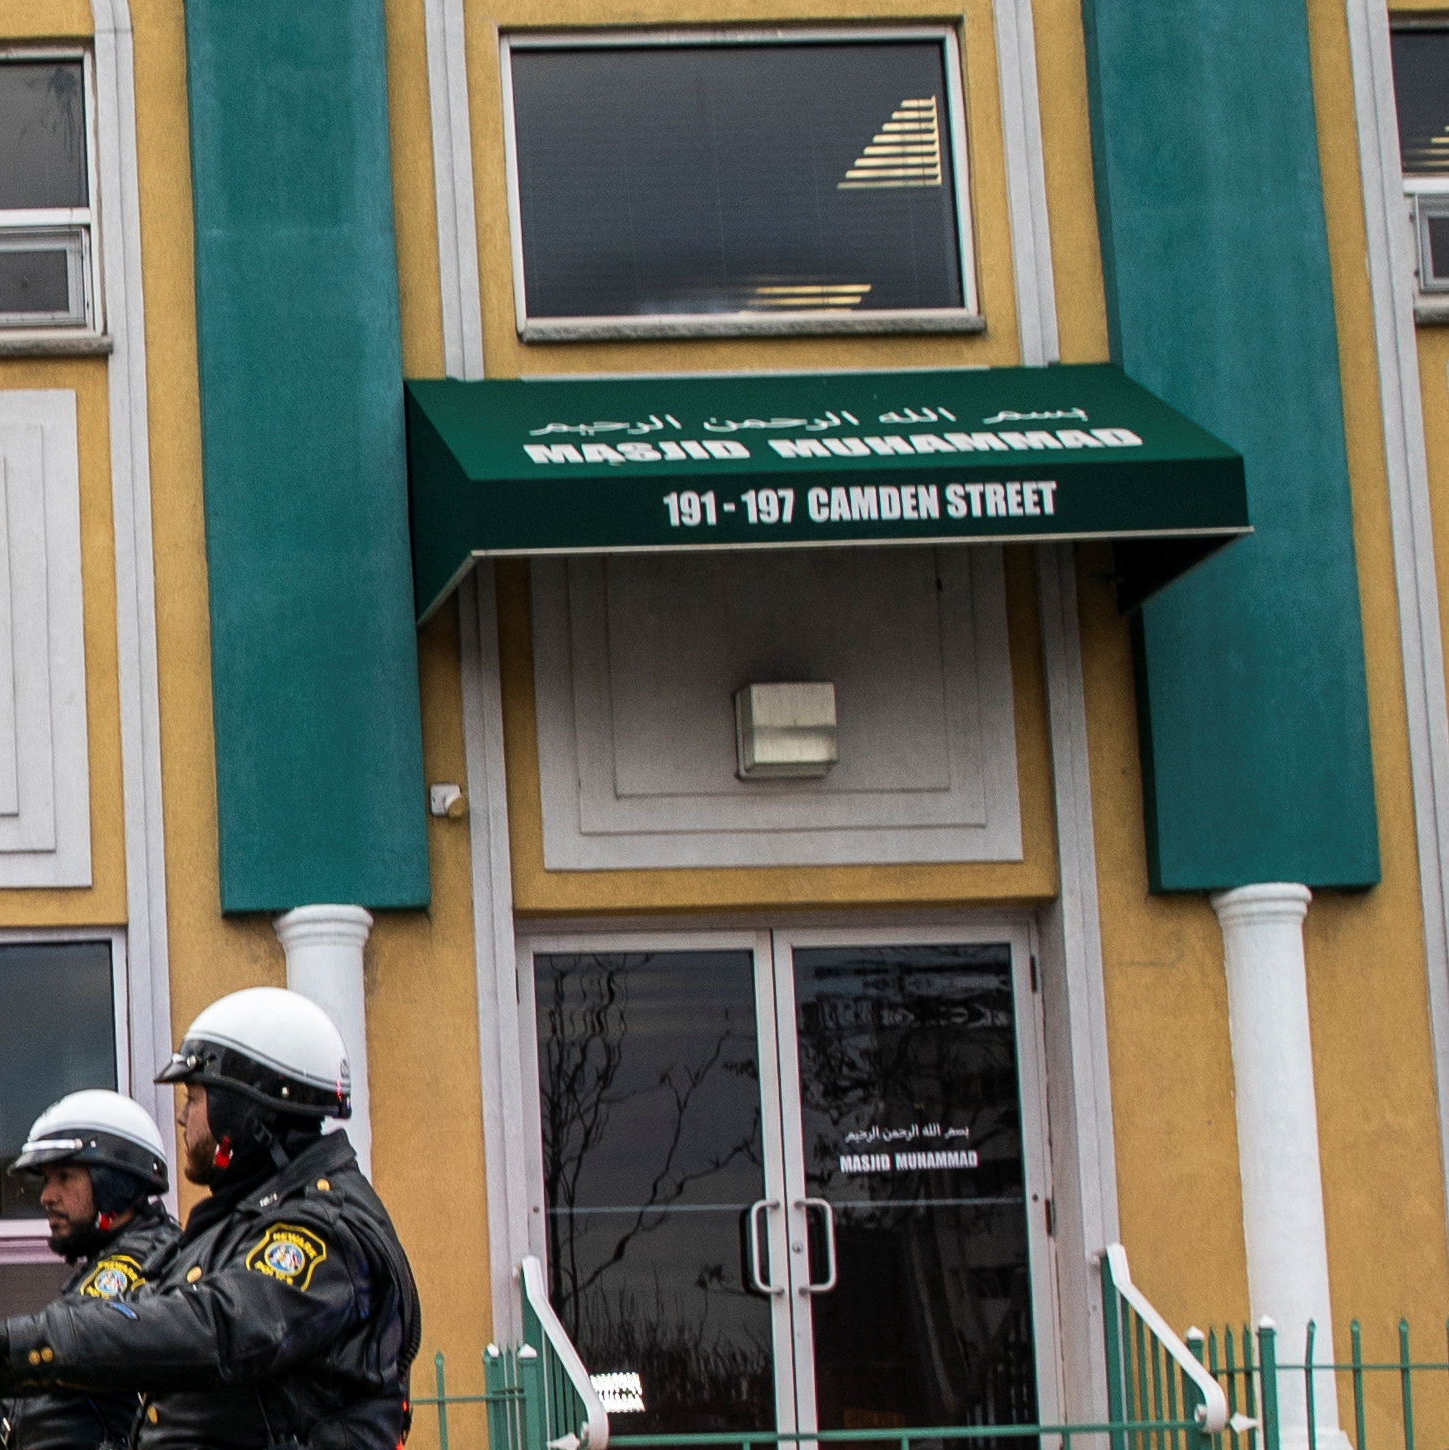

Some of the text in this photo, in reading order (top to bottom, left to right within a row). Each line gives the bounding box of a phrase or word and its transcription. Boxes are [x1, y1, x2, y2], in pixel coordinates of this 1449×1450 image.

[879, 407, 957, 425] الله
[522, 427, 1143, 464] MASJID MUHAMMAD
[807, 484, 940, 523] CAMDEN
[946, 480, 1058, 519] STREET
[839, 1149, 978, 1173] MASJID MUHAMMAD
